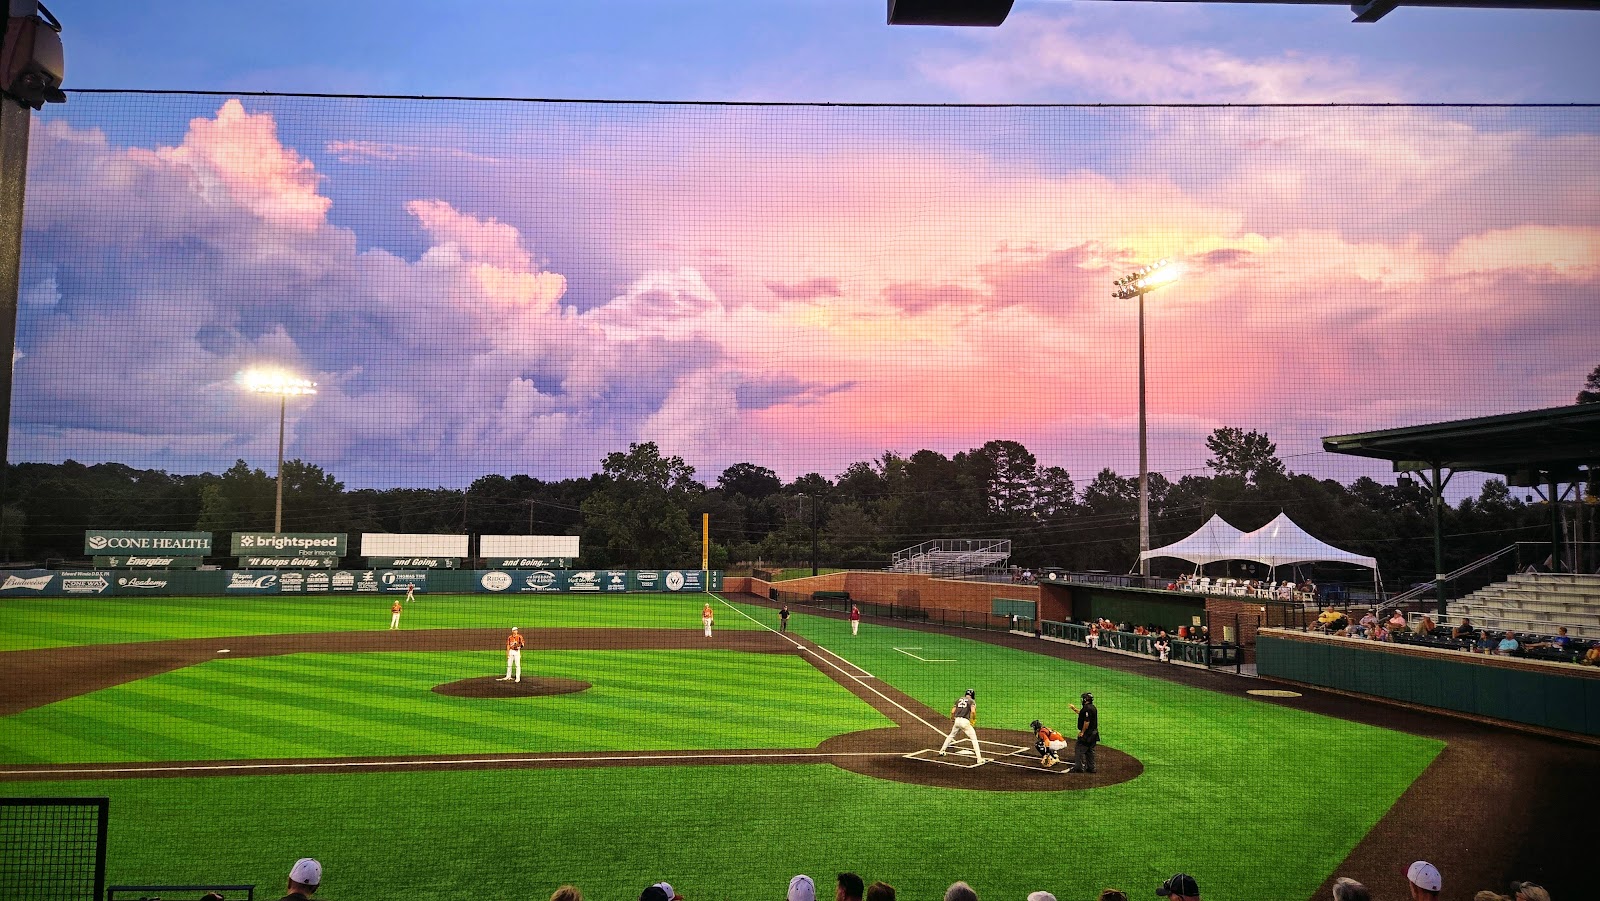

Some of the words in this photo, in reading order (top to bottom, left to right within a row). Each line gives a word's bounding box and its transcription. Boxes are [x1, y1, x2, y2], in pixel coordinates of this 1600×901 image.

[108, 537, 150, 549] CONE
[256, 536, 338, 550] brightspeed
[125, 556, 174, 567] Energizer
[261, 558, 288, 566] Keeps
[290, 558, 320, 567] Going,
[392, 558, 411, 566] and
[412, 558, 438, 567] Going,
[127, 577, 167, 588] Academy
[957, 698, 968, 709] 25
